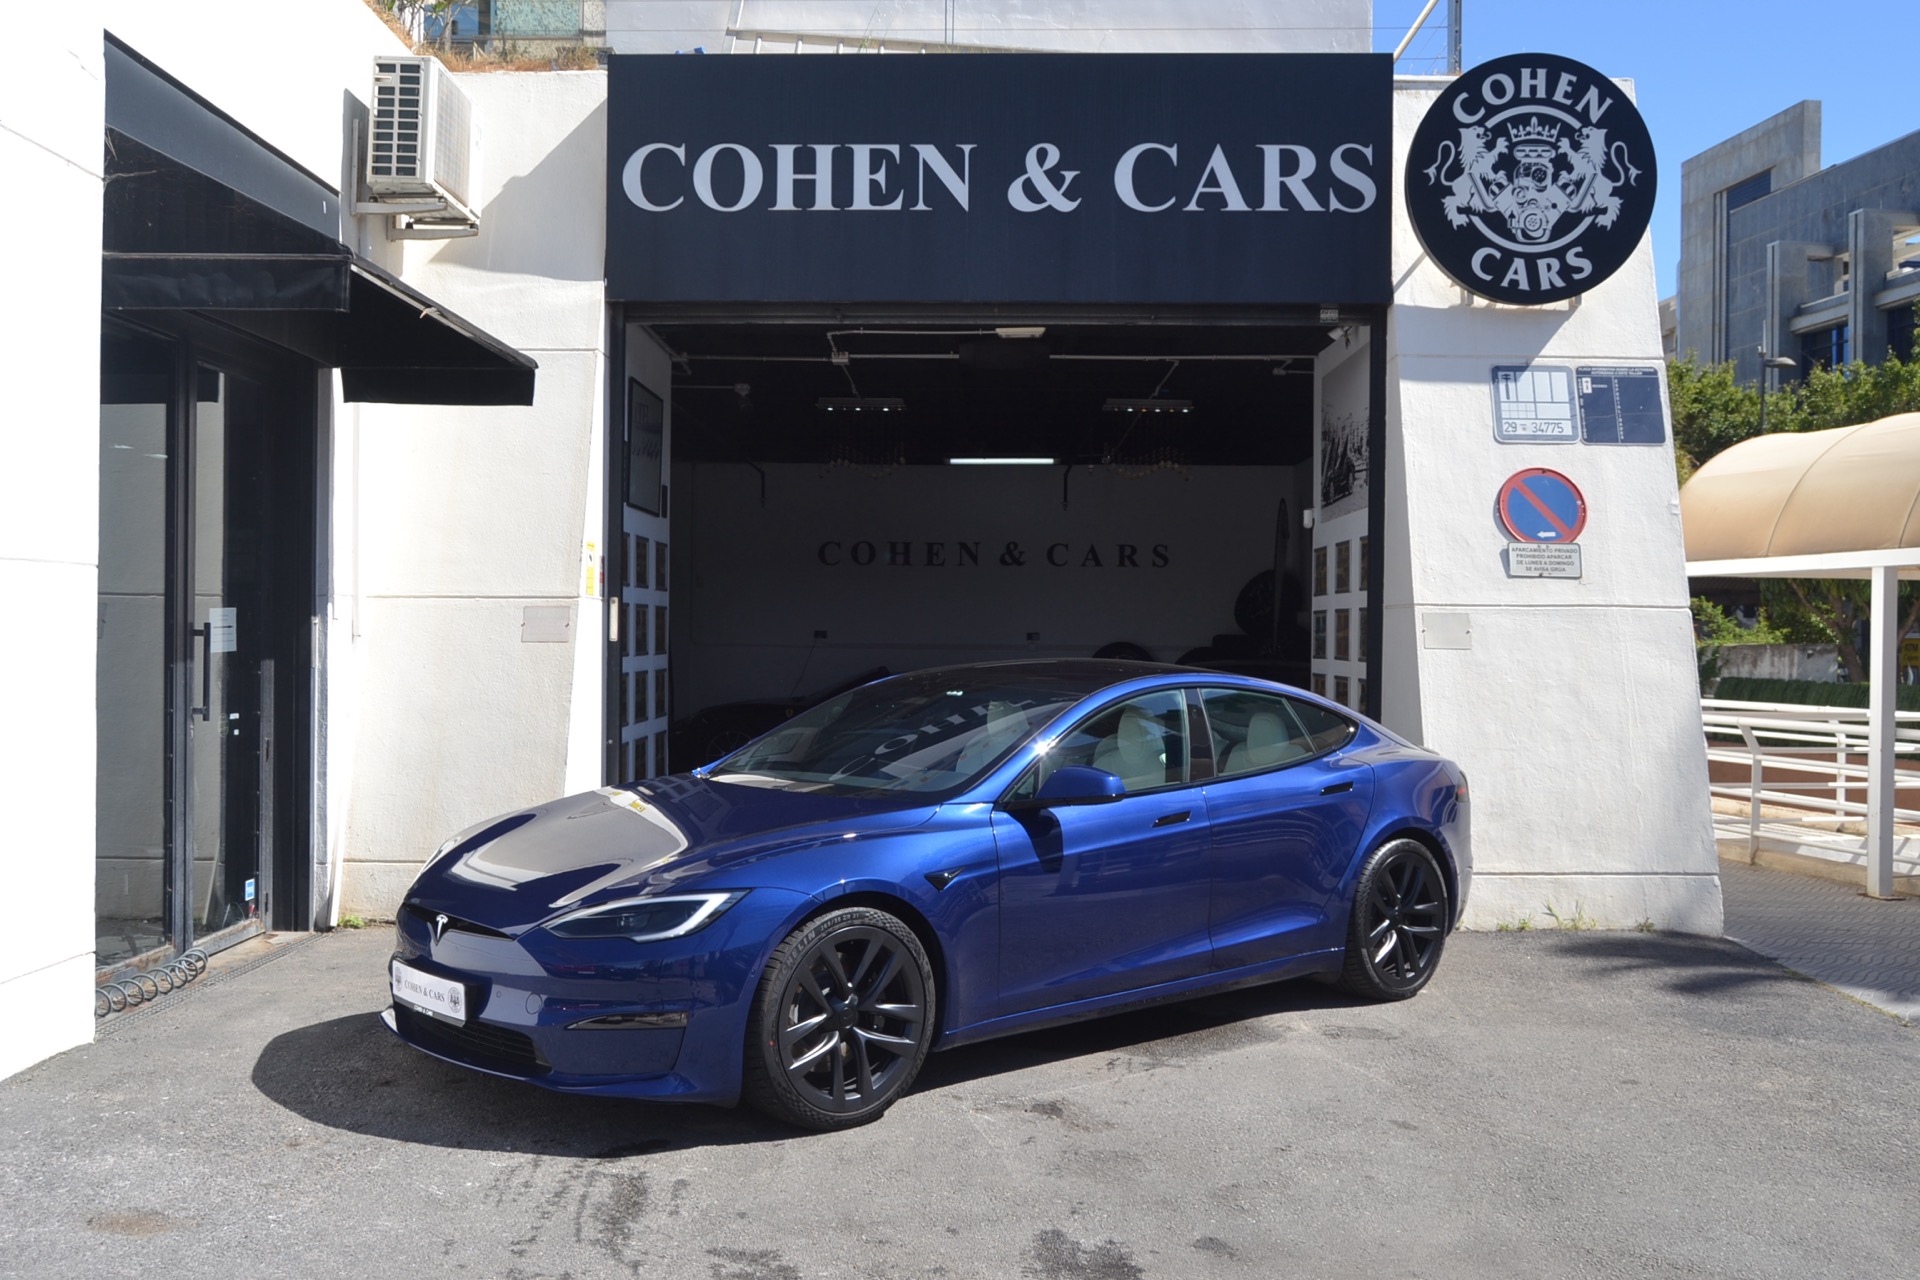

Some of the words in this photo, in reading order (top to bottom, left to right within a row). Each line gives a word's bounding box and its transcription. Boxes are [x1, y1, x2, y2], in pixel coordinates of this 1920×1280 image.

[1453, 68, 1614, 124] COHEN
[622, 141, 978, 213] COHEN
[1007, 141, 1082, 213] &
[1113, 141, 1377, 213] CARS
[1471, 246, 1593, 291] CARS
[1503, 421, 1518, 433] 29
[1531, 421, 1565, 434] 34775
[817, 541, 981, 567] COHEN
[1000, 541, 1026, 567] &
[1046, 543, 1170, 568] CARS
[404, 979, 422, 995] COHEN
[428, 989, 446, 1003] CARS
